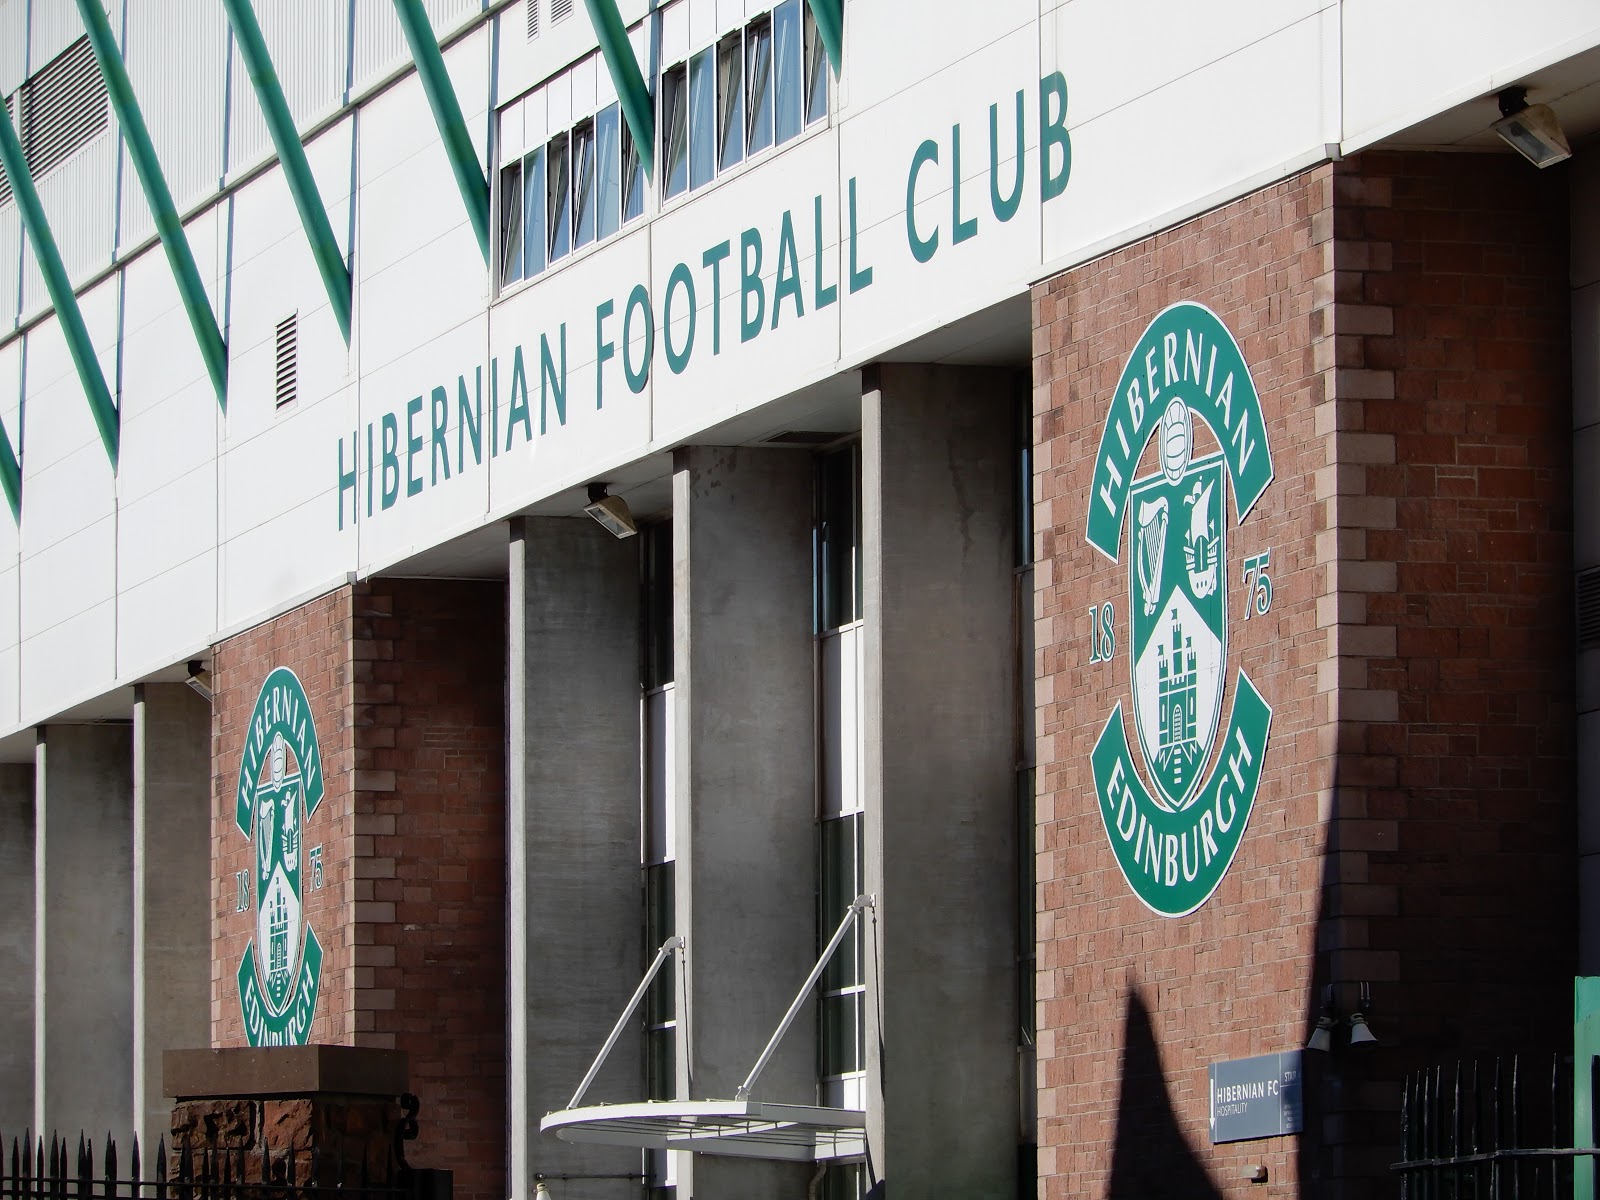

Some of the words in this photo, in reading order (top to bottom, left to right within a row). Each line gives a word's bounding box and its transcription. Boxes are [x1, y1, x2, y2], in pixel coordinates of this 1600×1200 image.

[338, 322, 566, 531] HIBERNIAN
[596, 176, 873, 410] FOOTBALL
[906, 70, 1073, 264] CLUB
[1099, 328, 1256, 518] HIBERNIAN
[1089, 601, 1116, 665] 18
[1242, 547, 1274, 620] 75
[241, 685, 316, 810] HIBERNIAN
[1106, 726, 1253, 887] EDINBURGH
[236, 868, 250, 913] 18
[309, 843, 324, 893] 75
[1216, 1081, 1264, 1104] HIBERNIAN
[1267, 1080, 1279, 1097] FC
[1216, 1102, 1248, 1117] HOSPITALITY
